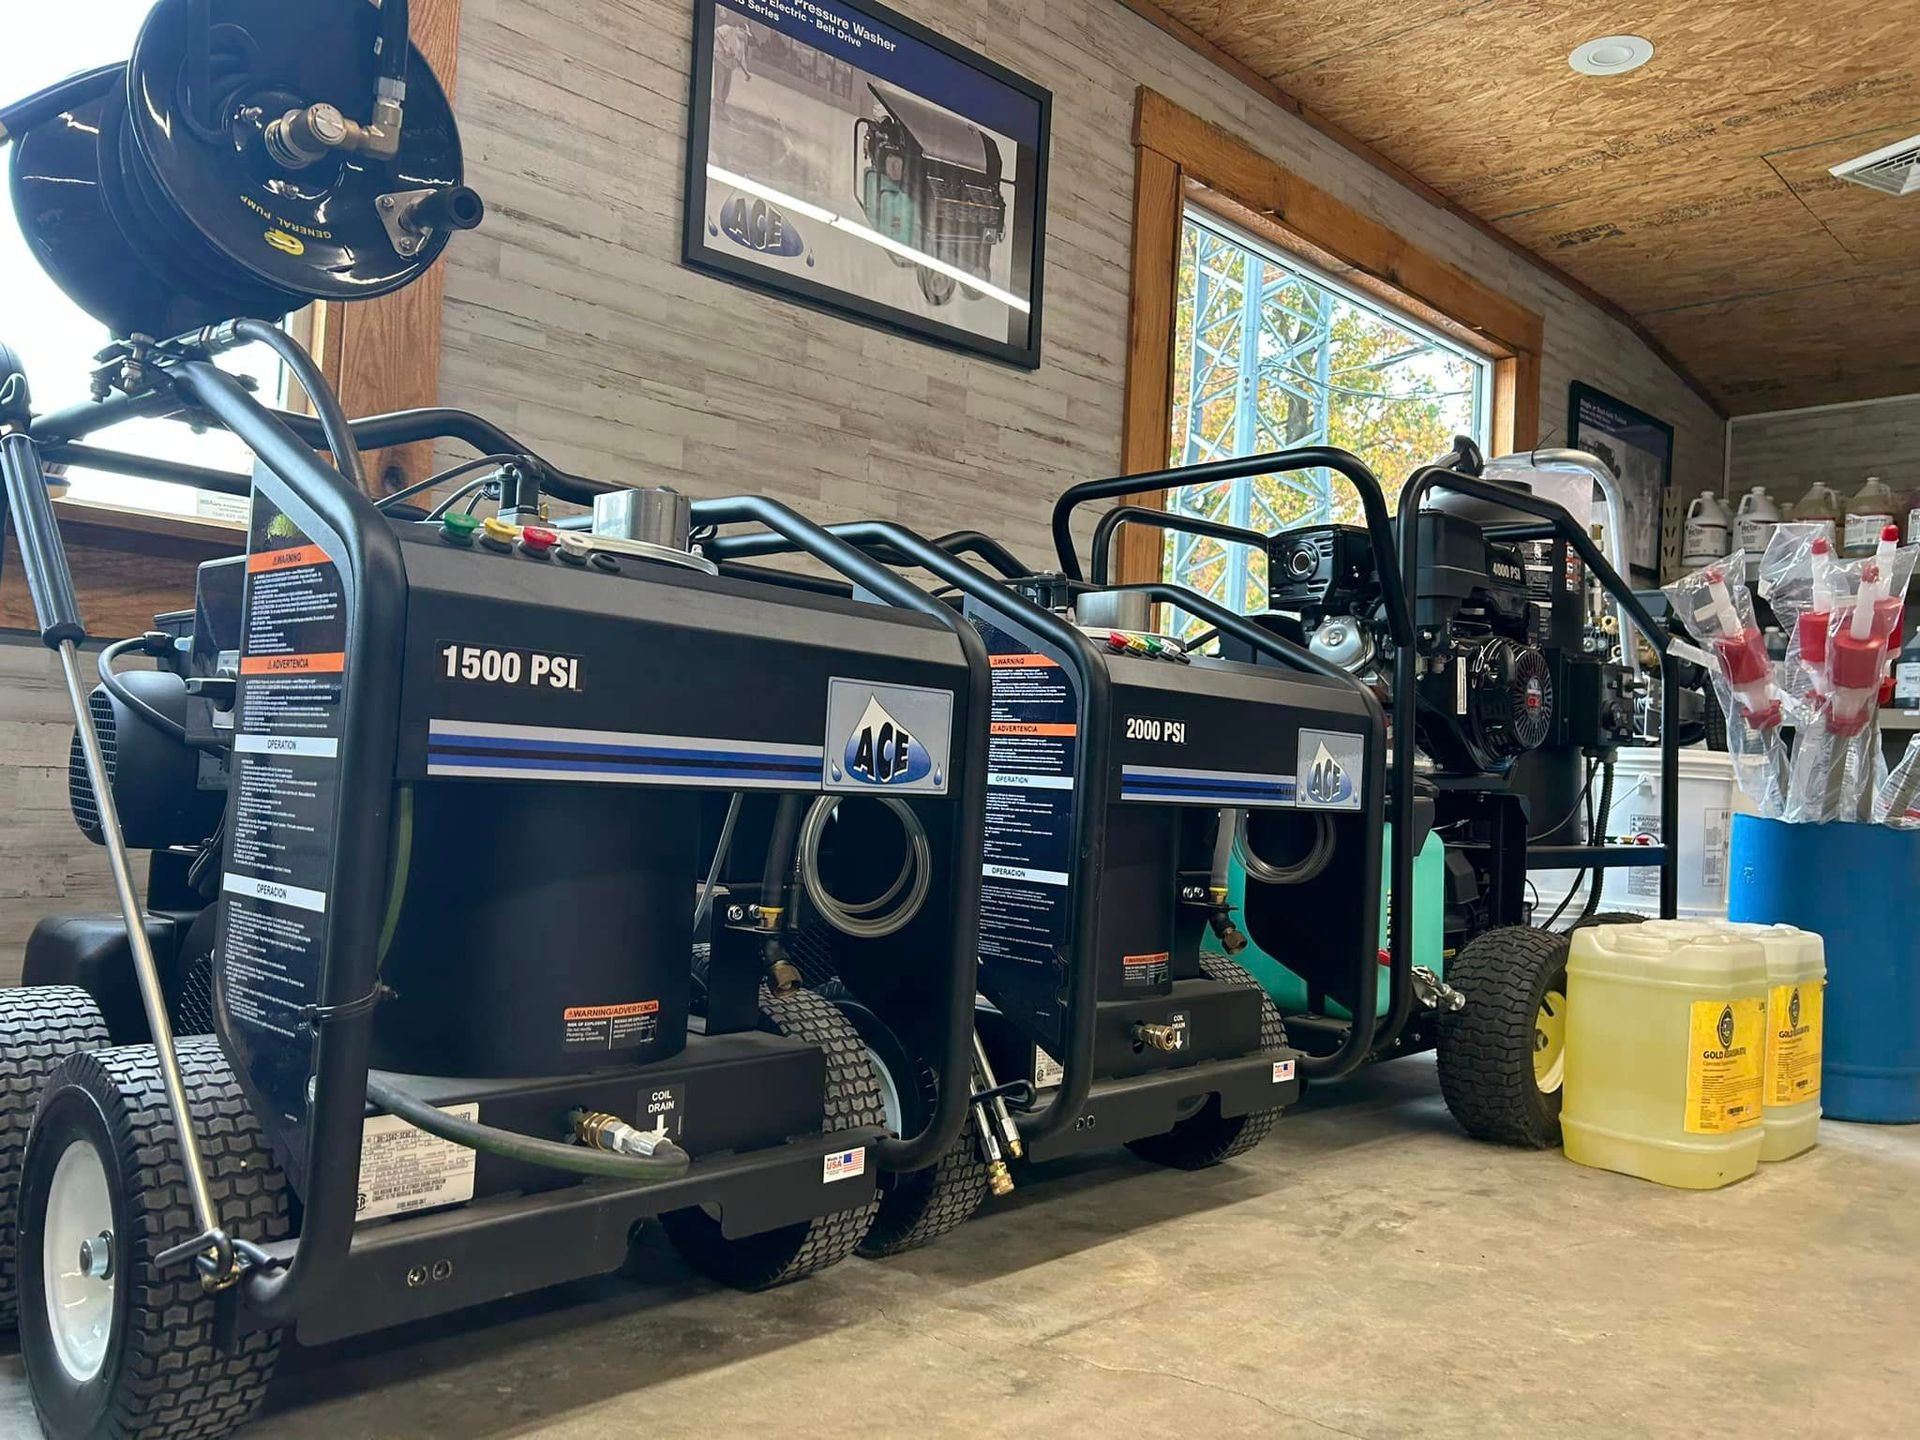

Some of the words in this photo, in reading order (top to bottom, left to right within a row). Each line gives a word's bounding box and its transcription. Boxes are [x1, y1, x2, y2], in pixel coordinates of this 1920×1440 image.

[747, 0, 780, 22] Series
[769, 0, 807, 22] Electric
[816, 18, 836, 37] Belt
[837, 29, 862, 48] Drive
[852, 21, 897, 52] Washer
[240, 195, 272, 221] PUMP
[276, 216, 332, 240] GENERAL
[728, 198, 783, 250] ACE
[273, 659, 309, 670] ADVERTENCIA
[443, 645, 521, 684] 1500
[530, 654, 578, 689] PSI
[997, 725, 1038, 733] ADVERTENCIA
[1126, 718, 1161, 741] 2000
[1164, 721, 1185, 743] PSI
[267, 739, 297, 750] OPERATION
[852, 721, 909, 783] ACE
[995, 775, 1029, 784] OPERATION
[1311, 758, 1341, 802] ACE
[992, 867, 1026, 878] OPERACION
[256, 883, 287, 899] OPERACION
[648, 1100, 675, 1113] DRAIN
[652, 1090, 672, 1101] COIL
[826, 1160, 842, 1170] USA
